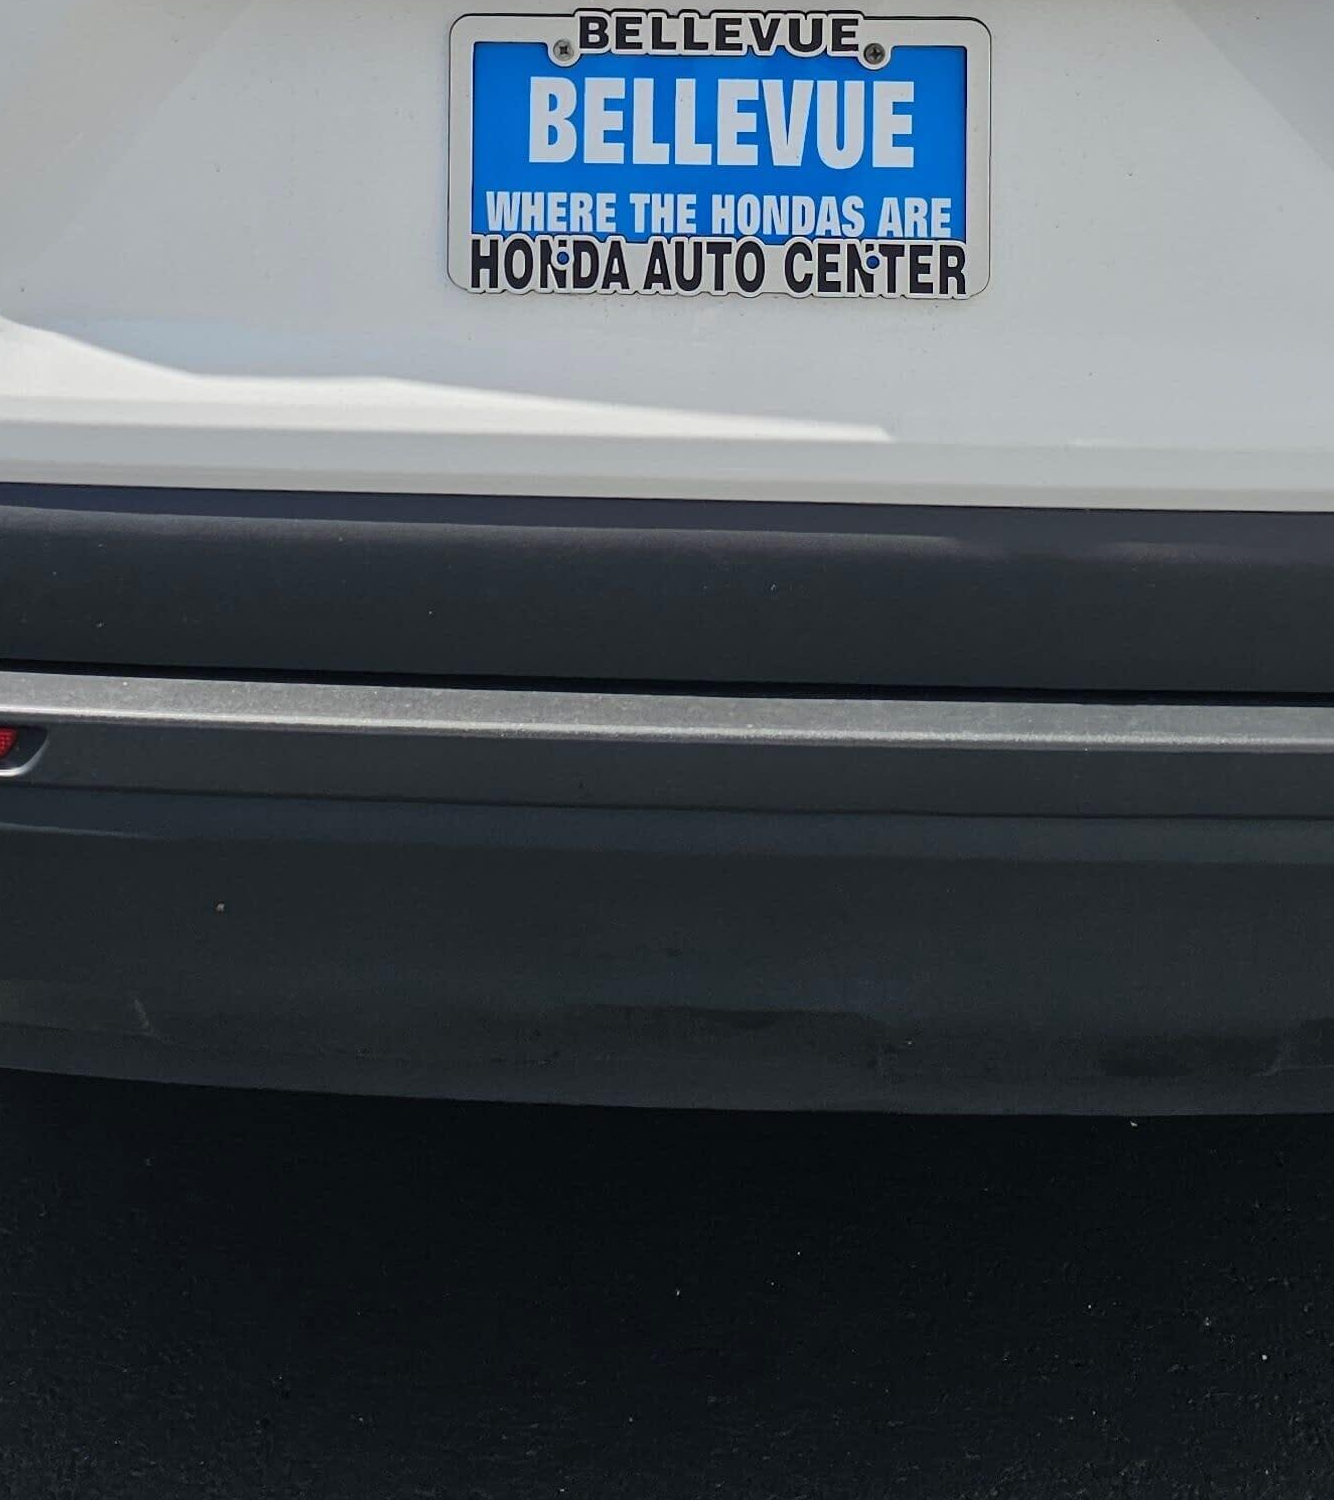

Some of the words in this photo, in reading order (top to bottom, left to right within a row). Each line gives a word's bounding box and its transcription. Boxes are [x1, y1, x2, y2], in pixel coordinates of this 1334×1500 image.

[579, 15, 859, 52] BELLEVUE
[528, 76, 915, 170] BELLEVUE
[486, 191, 617, 233] WHERE
[629, 193, 698, 235] THE
[711, 194, 865, 238] HONDAS
[878, 196, 952, 238] ARE
[470, 238, 629, 291] HONDA
[642, 240, 766, 293] AUTO
[783, 242, 967, 296] CENTER
